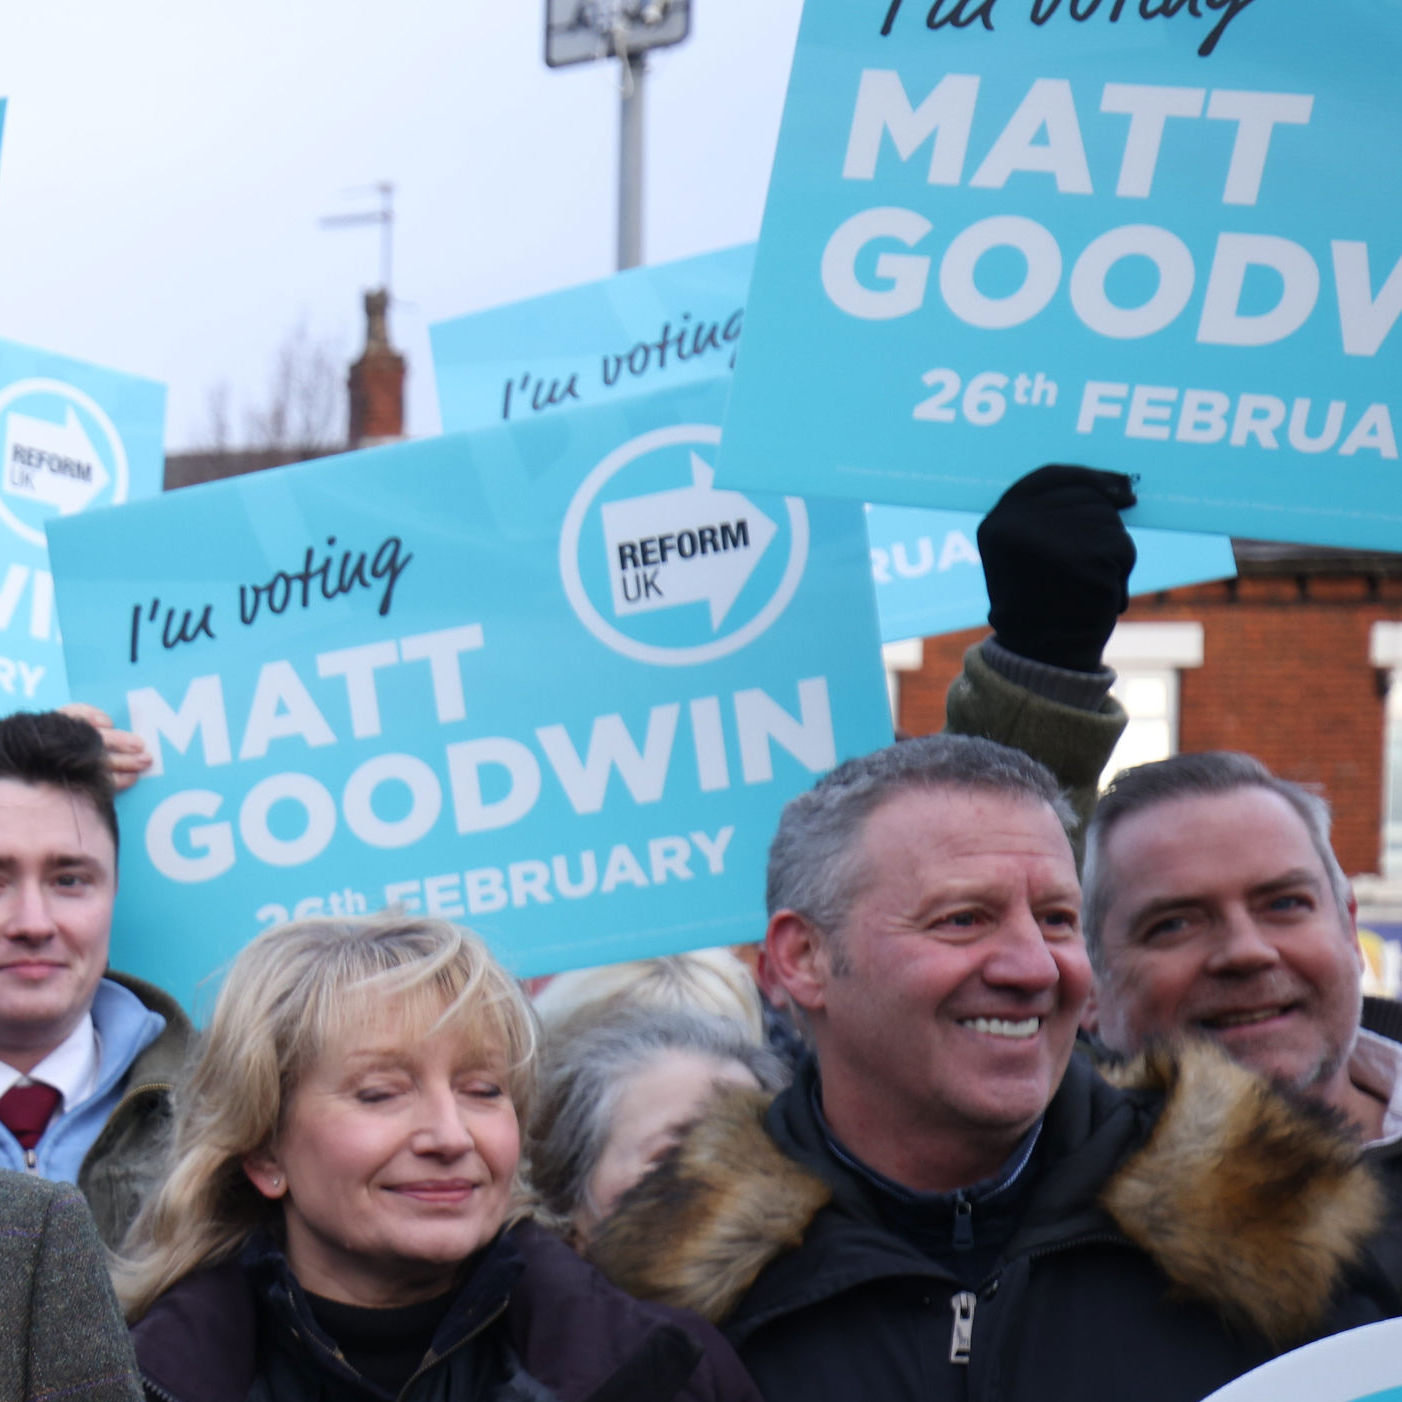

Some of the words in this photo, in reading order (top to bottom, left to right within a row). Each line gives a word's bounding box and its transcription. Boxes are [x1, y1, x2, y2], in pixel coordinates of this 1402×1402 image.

[842, 68, 1315, 206] MATT
[503, 370, 579, 419] I'm
[912, 367, 1058, 426] 26th
[9, 469, 35, 491] UK
[11, 442, 94, 483] REFORM
[618, 517, 750, 574] REFORM
[130, 598, 216, 663] I'm
[240, 536, 413, 625] voting
[621, 567, 665, 604] UK
[127, 623, 485, 778] MATT
[145, 675, 837, 884] GOODWIN
